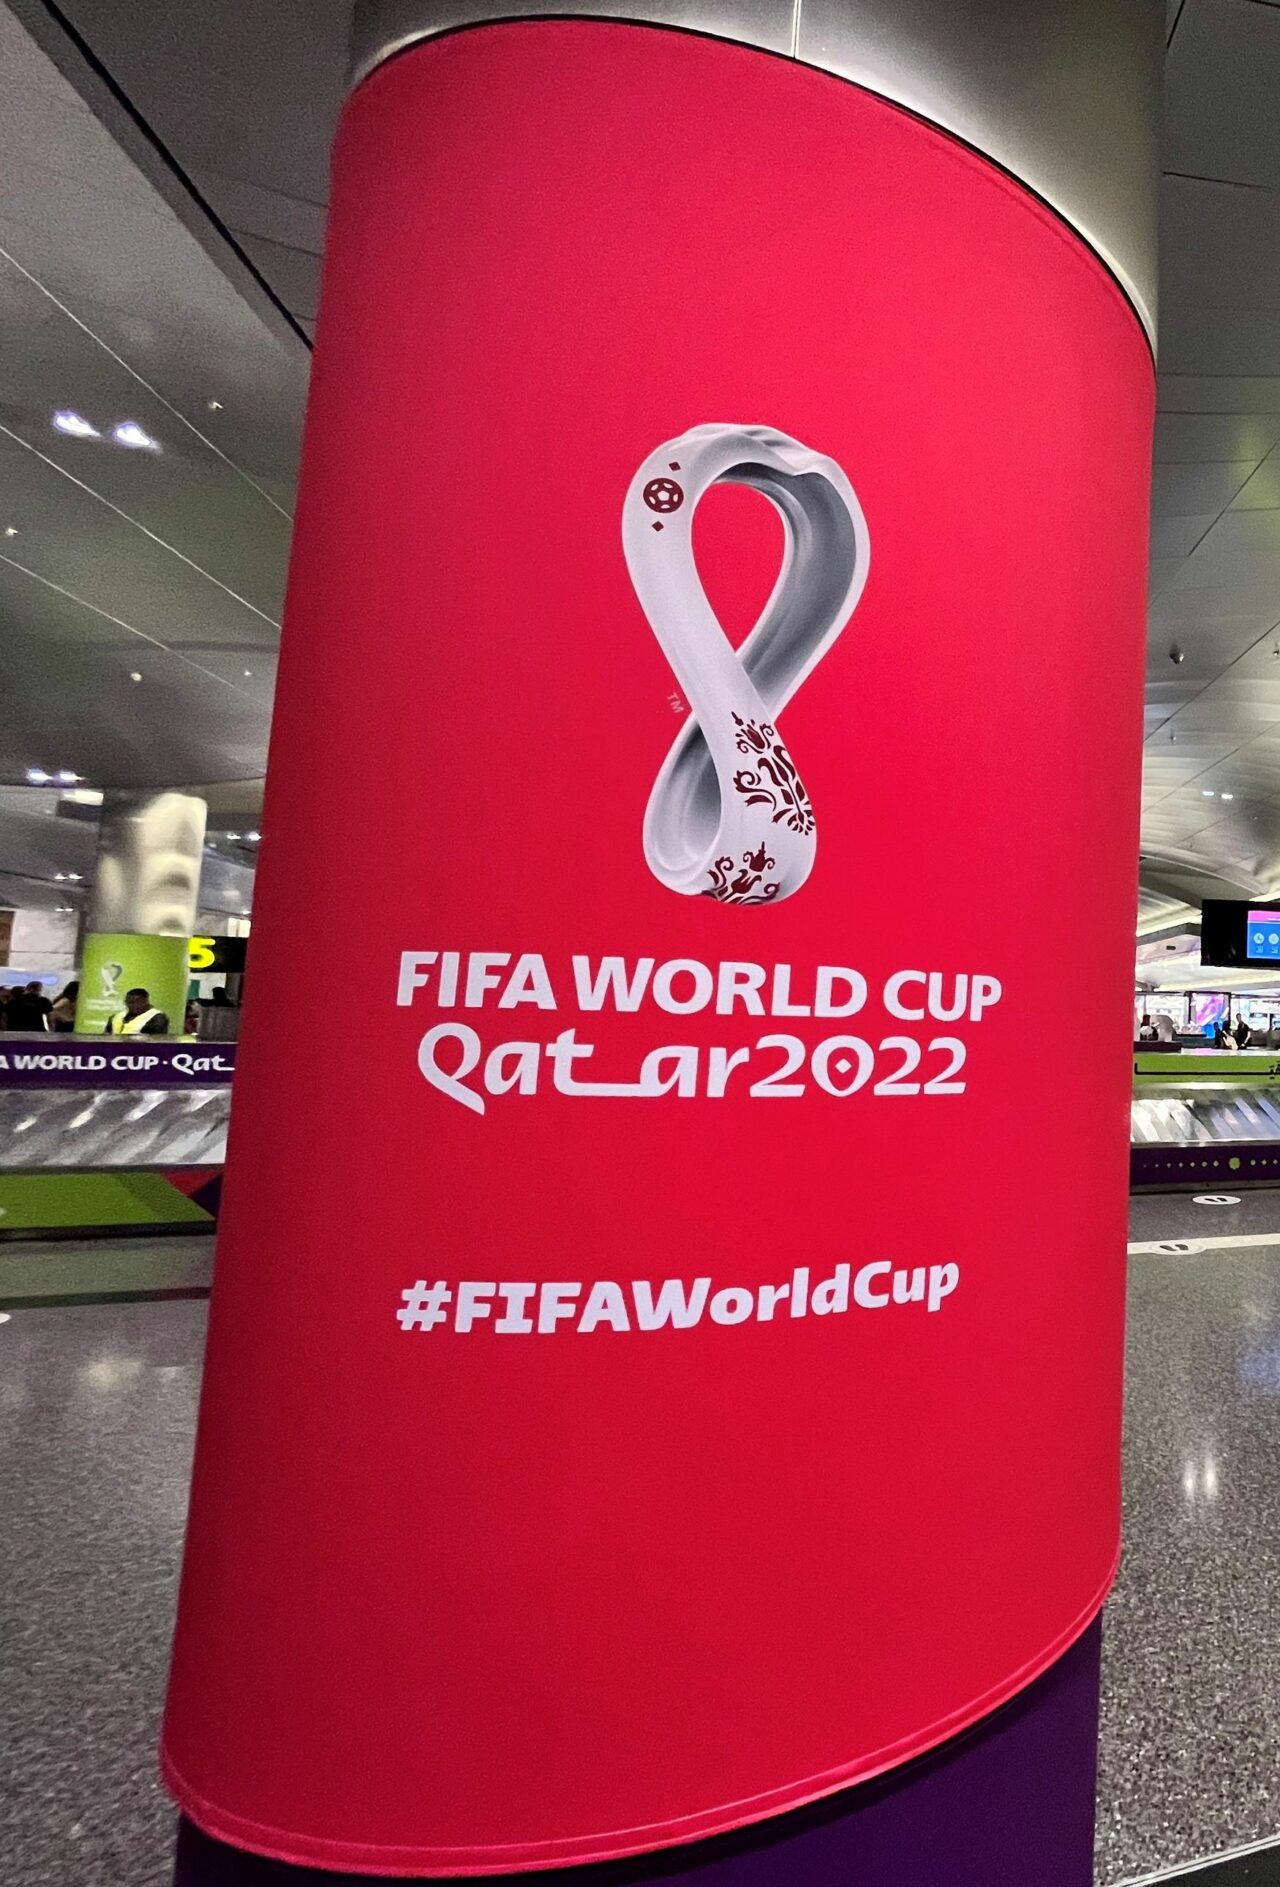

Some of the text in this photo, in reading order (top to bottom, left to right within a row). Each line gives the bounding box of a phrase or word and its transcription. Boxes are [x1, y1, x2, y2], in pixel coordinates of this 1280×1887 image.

[186, 936, 216, 969] 5
[396, 950, 1003, 1022] FIFA WORLD CUP
[14, 1054, 107, 1071] WORLD
[110, 1055, 159, 1071] CUP
[417, 1022, 967, 1116] Qatar2022
[396, 1260, 960, 1334] #FIFAWorldCup
